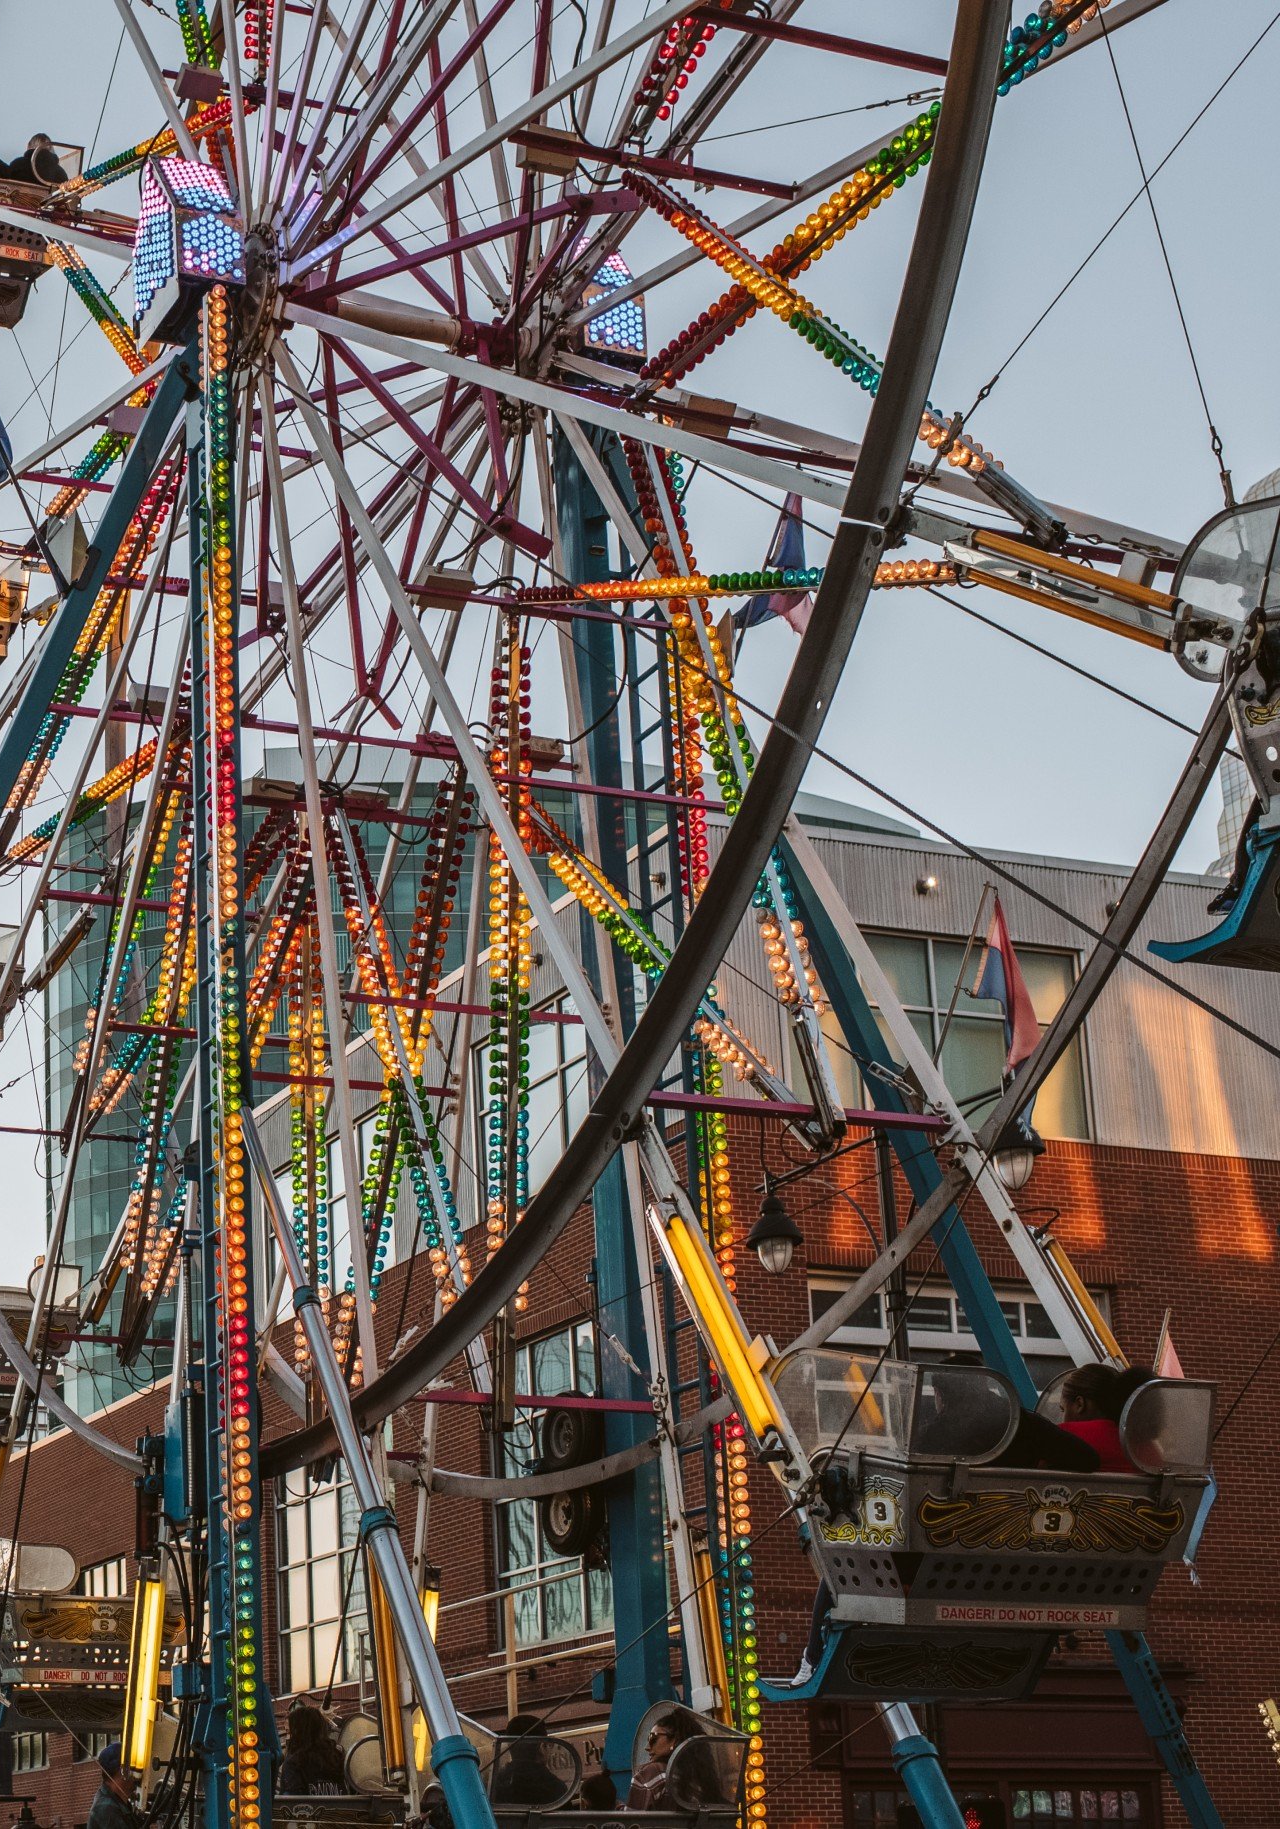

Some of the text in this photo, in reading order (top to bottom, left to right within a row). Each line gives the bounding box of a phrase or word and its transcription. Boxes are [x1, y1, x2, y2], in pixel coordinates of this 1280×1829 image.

[5, 247, 20, 257] ROCK
[24, 250, 39, 260] SEAT
[873, 1501, 887, 1521] 3
[1044, 1512, 1062, 1532] 3
[941, 1607, 1114, 1623] DANGER! DO NOT ROCK SEAT
[44, 1670, 74, 1681] DANGER!
[81, 1671, 90, 1681] DO
[94, 1672, 108, 1681] NOT
